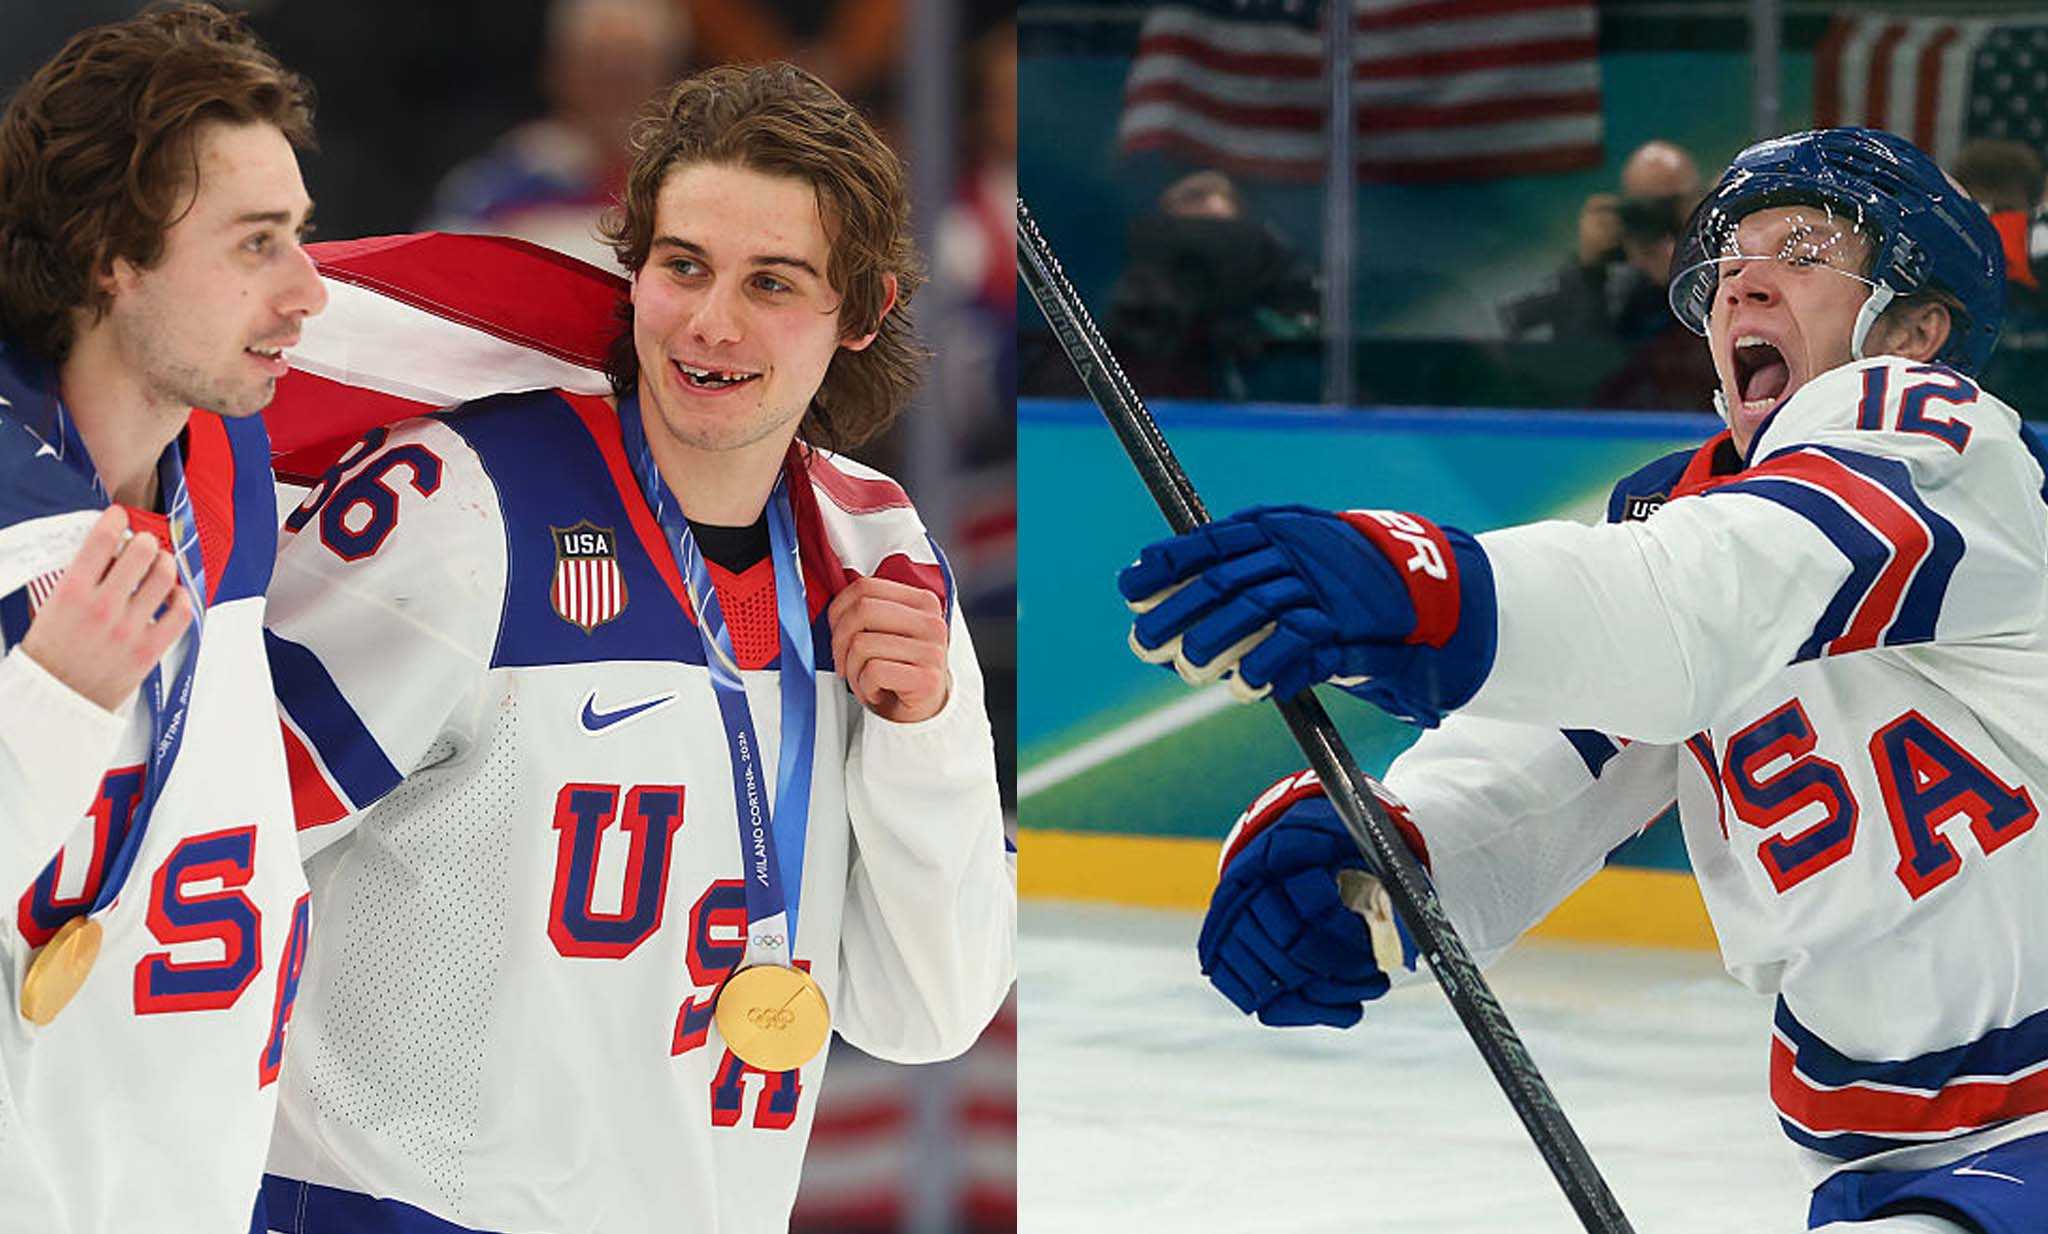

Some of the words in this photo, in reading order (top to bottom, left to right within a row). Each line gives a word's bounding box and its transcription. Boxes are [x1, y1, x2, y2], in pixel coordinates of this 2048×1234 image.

[1856, 363, 1979, 455] 12
[284, 427, 443, 562] 86
[564, 533, 609, 554] USA
[156, 708, 185, 766] ORTINA
[745, 762, 762, 827] CORTINA
[1685, 697, 2040, 900] SA
[752, 829, 770, 887] MILANO
